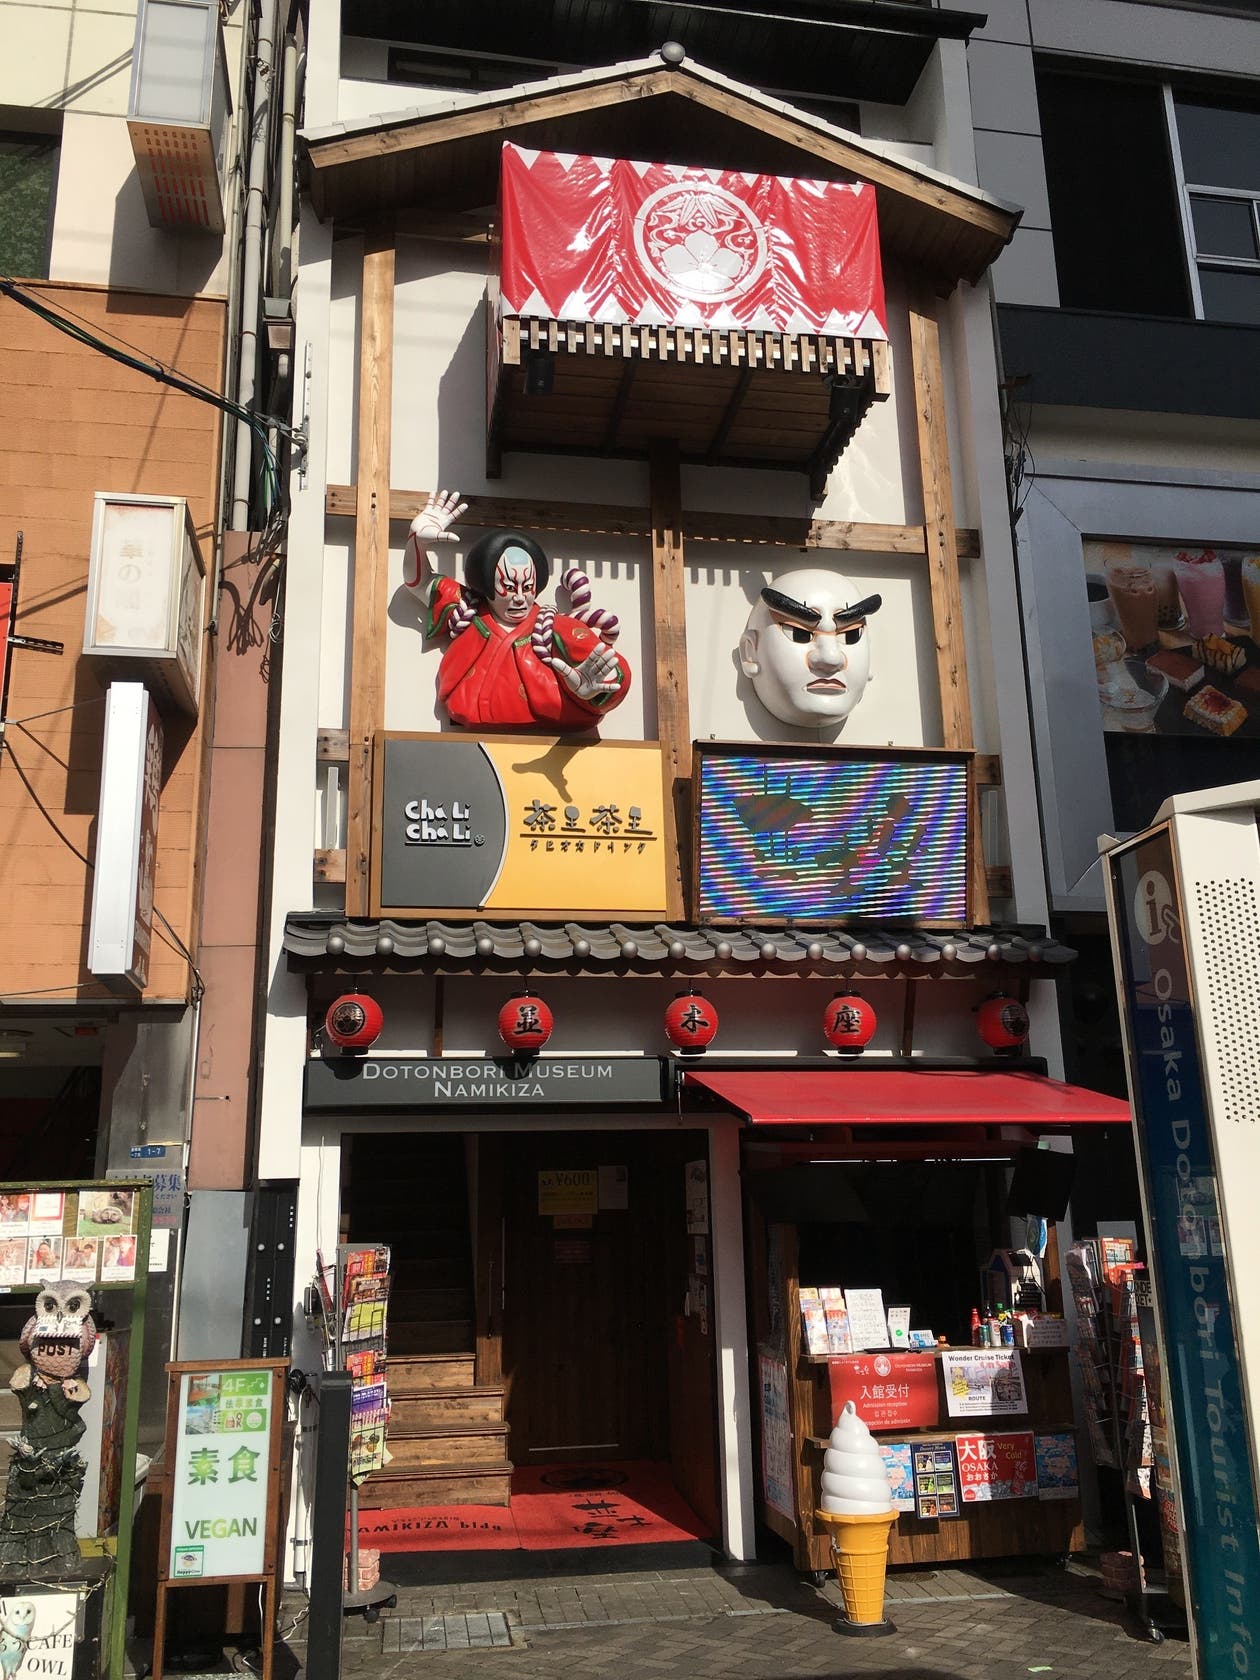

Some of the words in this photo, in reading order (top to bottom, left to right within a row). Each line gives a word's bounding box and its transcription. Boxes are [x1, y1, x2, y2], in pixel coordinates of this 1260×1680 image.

[680, 1005, 709, 1033] 木
[832, 1005, 862, 1034] 座
[362, 1063, 504, 1080] DOTONBORI
[514, 1064, 613, 1079] MUSEUM
[434, 1081, 545, 1098] NAMIKIZA
[1155, 968, 1183, 1101] Osaka
[1204, 1379, 1240, 1552] Tourist
[1224, 1568, 1252, 1680] Info
[38, 1343, 73, 1357] POST
[222, 1378, 246, 1393] 4F
[860, 1383, 910, 1400] 入館受付
[958, 1439, 997, 1461] 大阪
[997, 1442, 1015, 1450] Very
[187, 1445, 260, 1486] 素食
[961, 1461, 999, 1473] OSAKA
[966, 1471, 999, 1481] おおさか
[185, 1517, 257, 1540] VEGAN
[345, 1520, 449, 1534] AMIKIZA
[27, 1633, 73, 1651] CAFE
[27, 1657, 67, 1676] OWL
